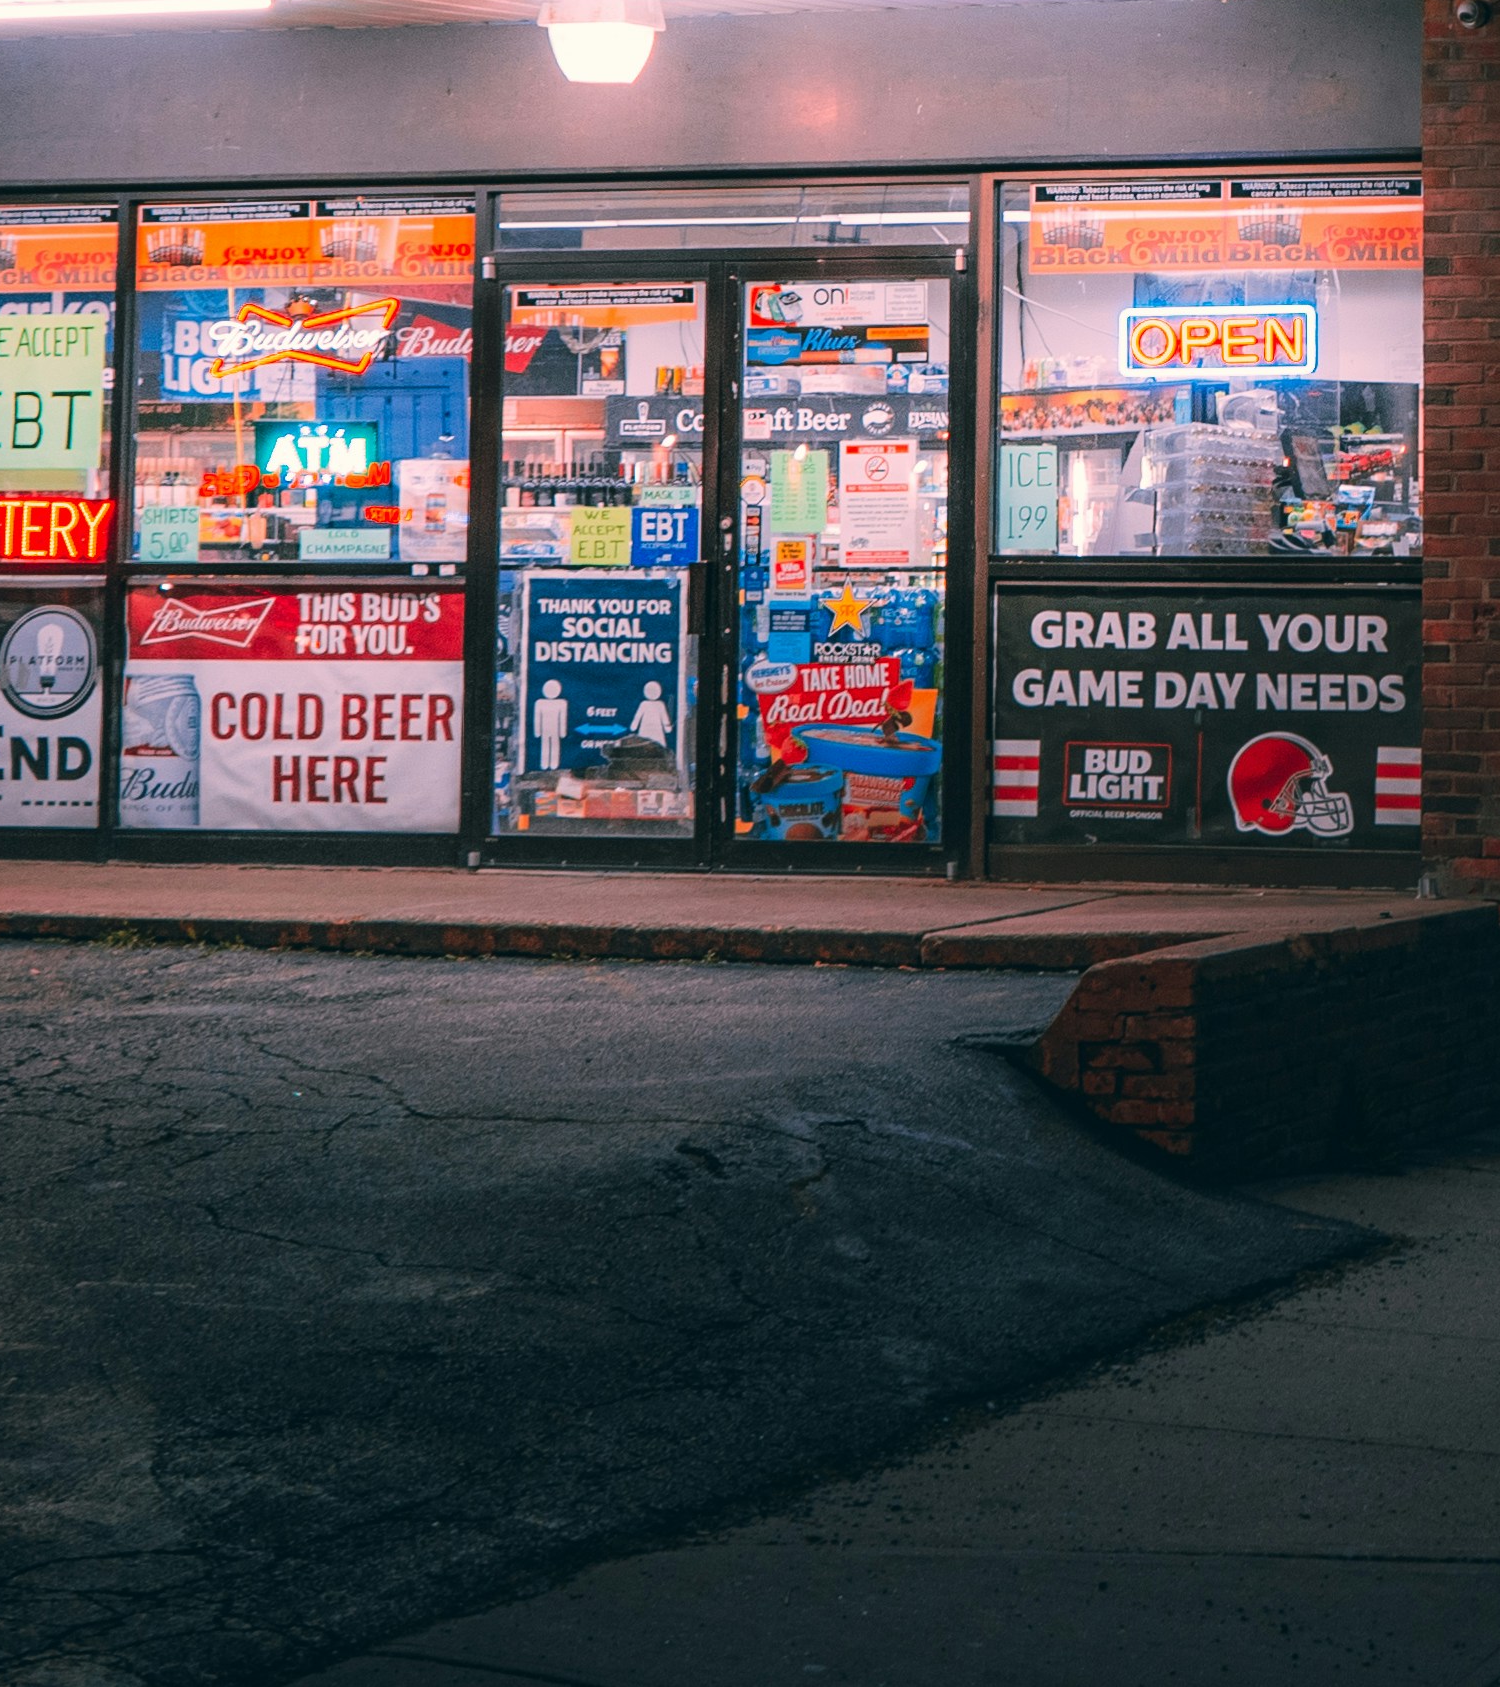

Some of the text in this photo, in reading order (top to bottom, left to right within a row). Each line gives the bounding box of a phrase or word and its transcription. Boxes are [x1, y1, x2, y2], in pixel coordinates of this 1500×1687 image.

[1033, 246, 1123, 265] Black
[1152, 244, 1221, 263] Mild
[1228, 243, 1321, 262] Black
[1347, 241, 1420, 261] Mild
[813, 287, 849, 306] on!
[15, 326, 95, 358] ACCEPT
[208, 318, 392, 359] Budweiser
[801, 328, 861, 351] Blues
[1130, 317, 1304, 366] OPEN
[796, 407, 852, 432] Beer
[265, 433, 367, 474] ATM
[1008, 450, 1053, 488] ICE
[643, 490, 673, 500] MASK
[143, 506, 199, 526] SHIRTS
[584, 510, 611, 520] WE
[640, 511, 689, 542] EBT
[1007, 505, 1049, 540] 1.99
[573, 524, 626, 536] ACCEPT
[306, 543, 388, 555] CHAMPAGNE
[154, 606, 260, 633] Budweiser
[296, 592, 441, 623] THIS BUD'S
[537, 598, 671, 616] THANK YOU FOR
[295, 624, 414, 655] FOR YOU.
[561, 616, 647, 639] SOCIAL
[1030, 610, 1388, 653] GRAB ALL YOUR
[9, 654, 85, 666] PLATFORM
[534, 641, 672, 664] DISTANCING
[800, 662, 891, 692] TAKE HOME
[1012, 668, 1407, 712] GAME DAY NEEDS
[210, 691, 455, 742] COLD BEER
[586, 705, 618, 718] 6 FEET
[766, 687, 890, 724] Real Deal
[1083, 748, 1153, 775] BUD
[272, 755, 389, 804] HERE
[1069, 775, 1164, 801] LIGHT
[1069, 809, 1163, 820] OFFICIAL BEER SPONSOR
